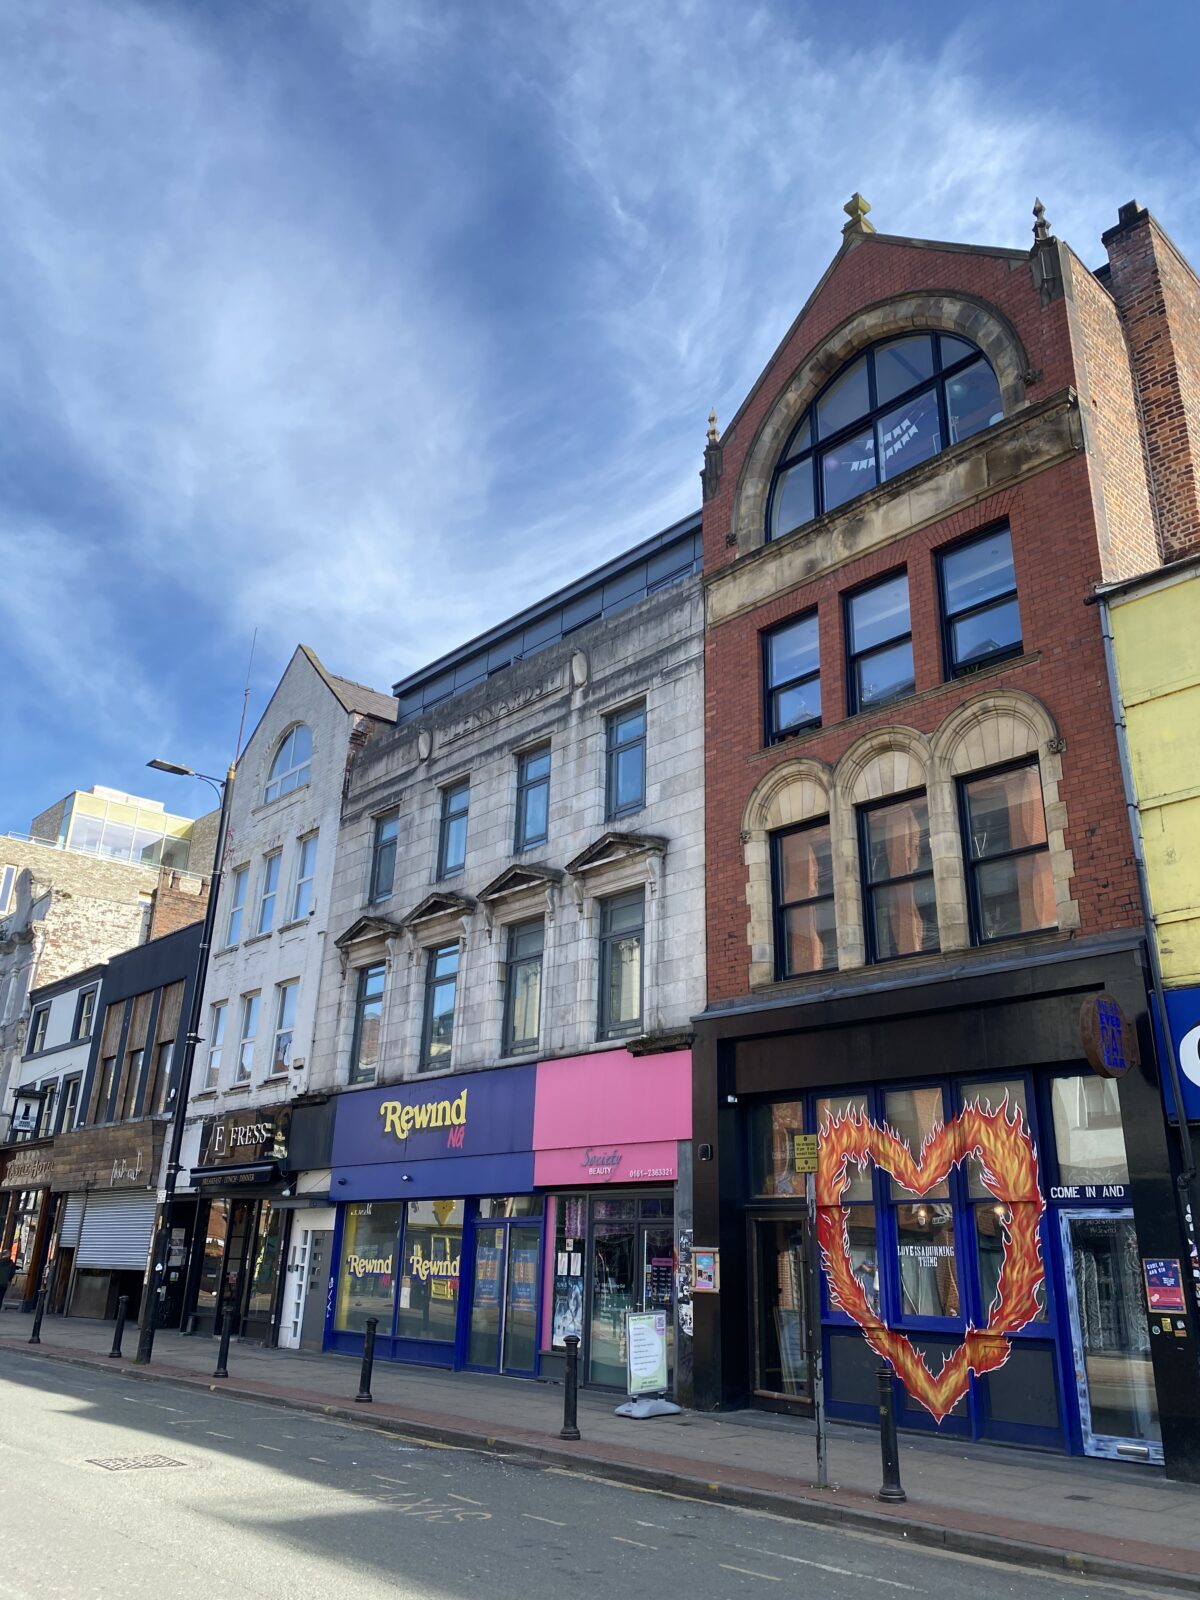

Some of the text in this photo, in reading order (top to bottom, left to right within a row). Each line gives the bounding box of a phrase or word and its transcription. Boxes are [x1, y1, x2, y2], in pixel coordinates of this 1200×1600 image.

[380, 1087, 468, 1139] Rewind
[229, 1122, 269, 1147] FRESS
[447, 1125, 465, 1149] NQ
[588, 1167, 612, 1175] BEAUTY
[1050, 1185, 1124, 1198] COME IN AND
[348, 1254, 460, 1280] Rewind Rewind
